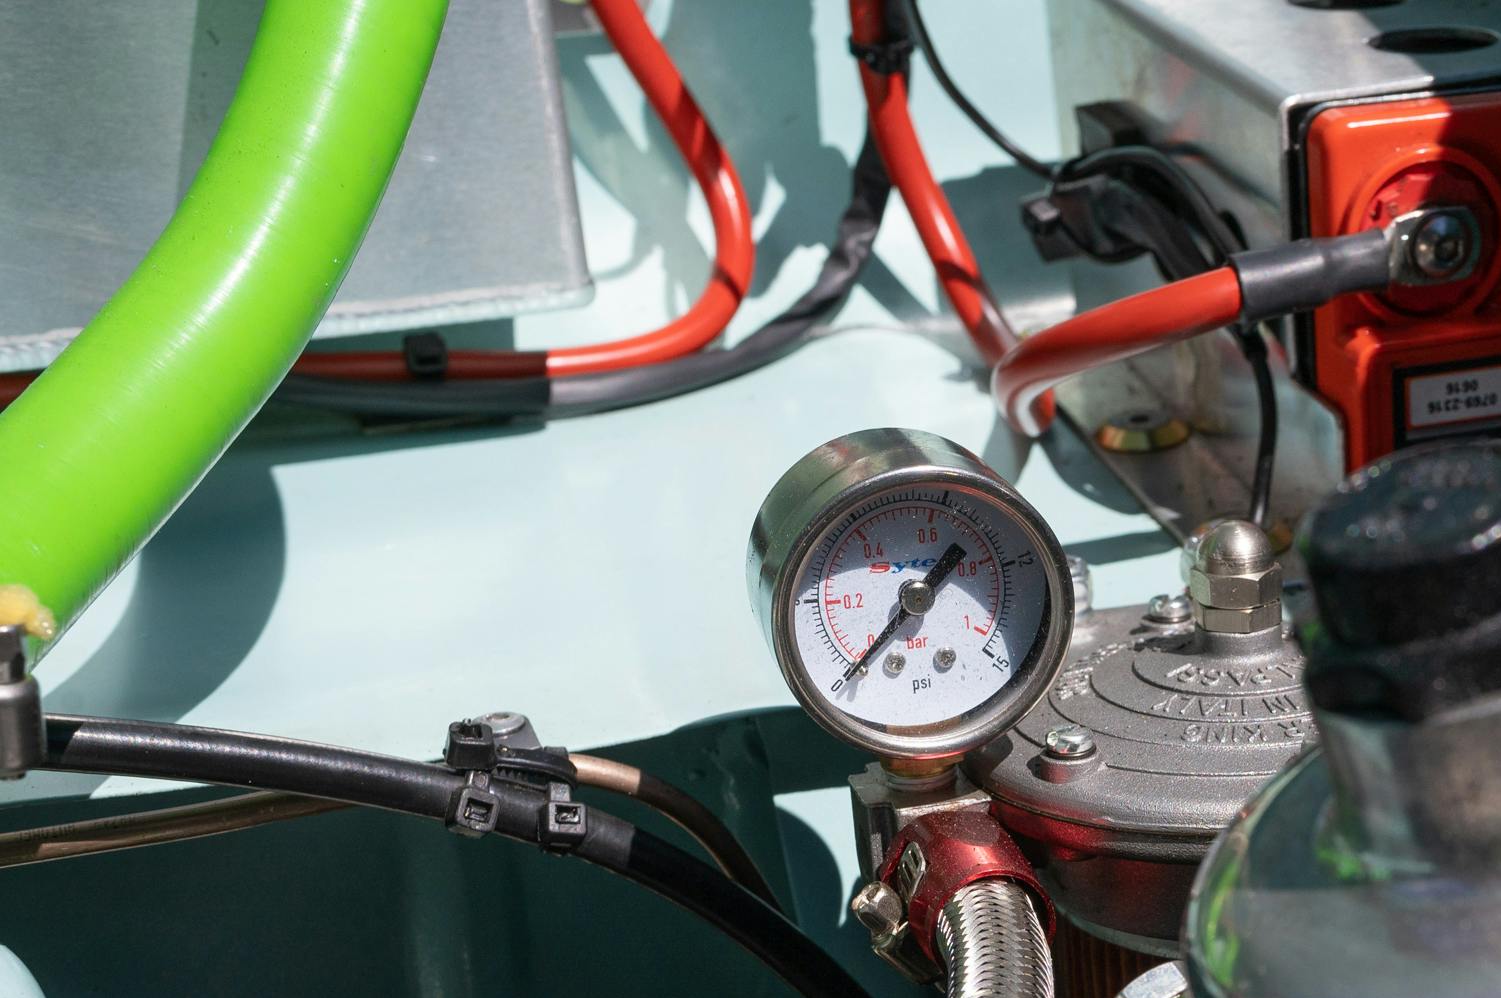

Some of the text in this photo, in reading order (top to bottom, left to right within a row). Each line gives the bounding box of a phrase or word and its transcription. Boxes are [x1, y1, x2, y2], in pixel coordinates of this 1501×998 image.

[918, 527, 938, 544] 0.6
[863, 543, 883, 559] 0.4
[869, 556, 938, 574] Syte
[957, 560, 977, 577] 0.8
[1016, 550, 1034, 570] 12
[843, 593, 864, 609] 0.2
[963, 615, 970, 630] 1
[906, 634, 929, 650] bar
[992, 657, 1010, 673] 15
[830, 679, 844, 692] 0
[912, 673, 932, 694] psi
[1151, 694, 1301, 716] IN ITALY
[1181, 724, 1267, 743] KING
